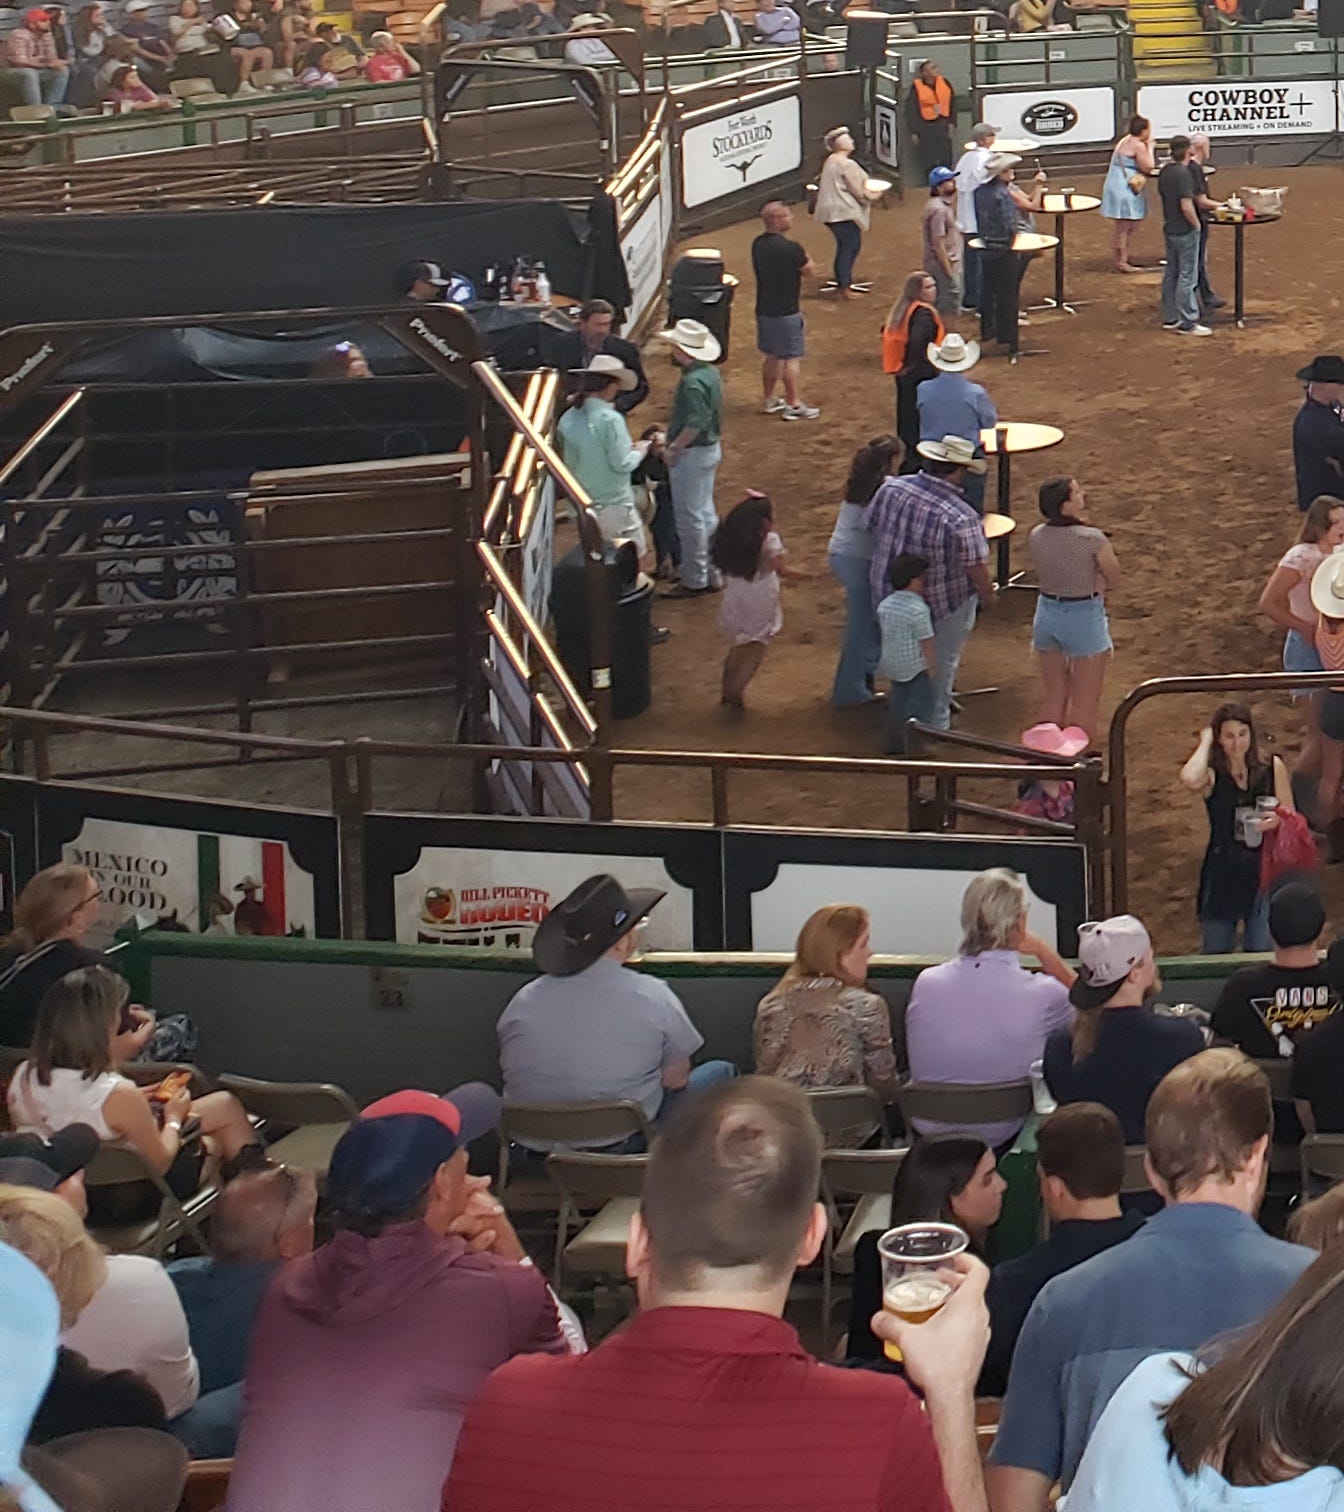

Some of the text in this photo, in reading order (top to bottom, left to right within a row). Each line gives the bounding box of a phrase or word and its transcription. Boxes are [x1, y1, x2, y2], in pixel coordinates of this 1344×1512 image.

[1188, 88, 1289, 106] COWBOY
[1188, 106, 1290, 122] CHANNEL
[1208, 123, 1255, 131] STREAMING
[713, 120, 773, 158] STOCKYARDS
[409, 318, 464, 362] Priefert
[73, 849, 168, 877] MEXICO
[114, 873, 151, 889] OUR
[1276, 986, 1328, 1007] VANS
